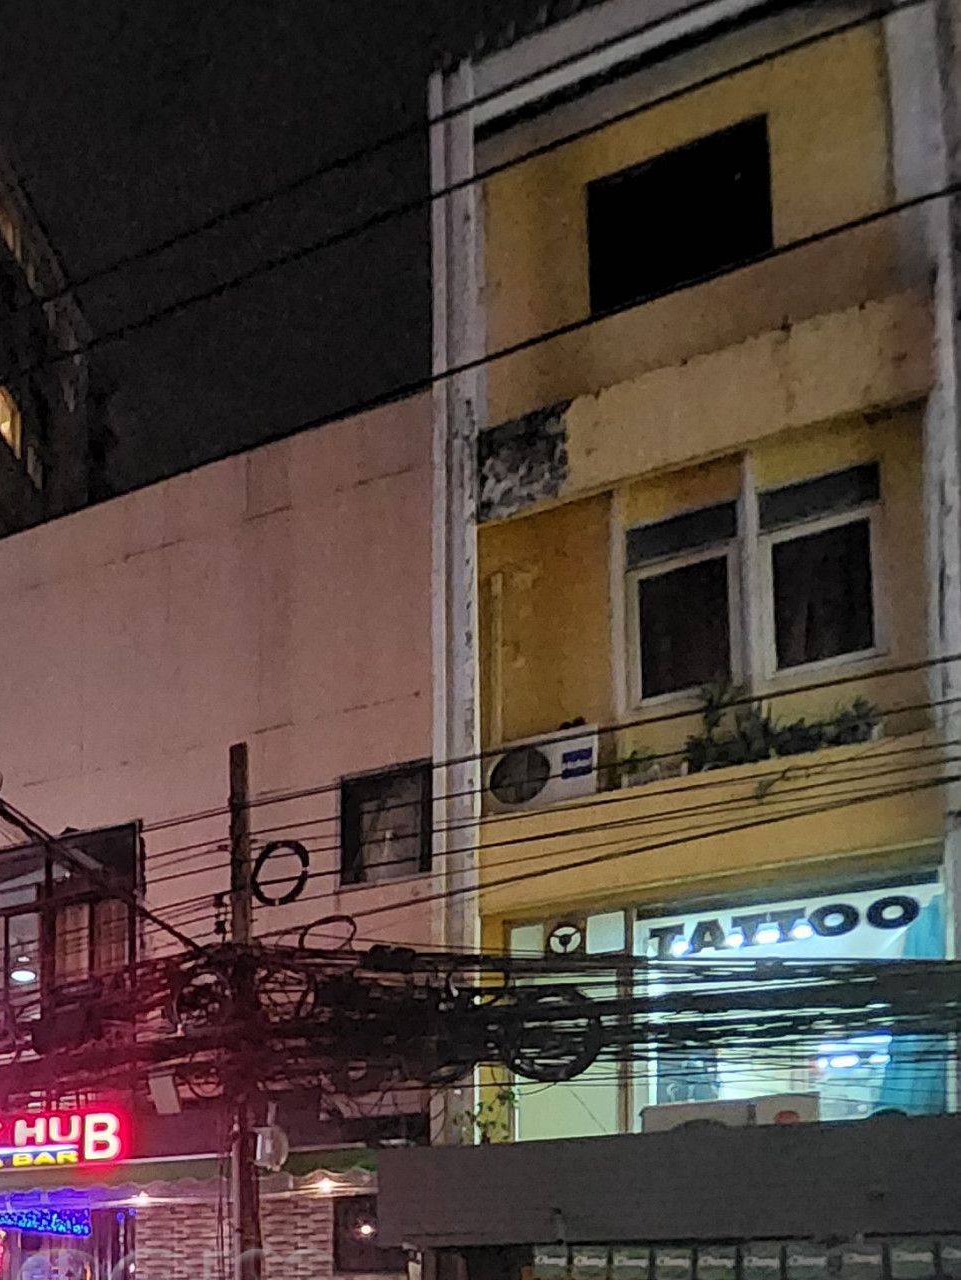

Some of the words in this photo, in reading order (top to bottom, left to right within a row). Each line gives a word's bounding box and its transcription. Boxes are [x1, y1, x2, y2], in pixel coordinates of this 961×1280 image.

[648, 895, 921, 958] TATTOO
[12, 1150, 79, 1168] BAR
[13, 1112, 122, 1161] HUB
